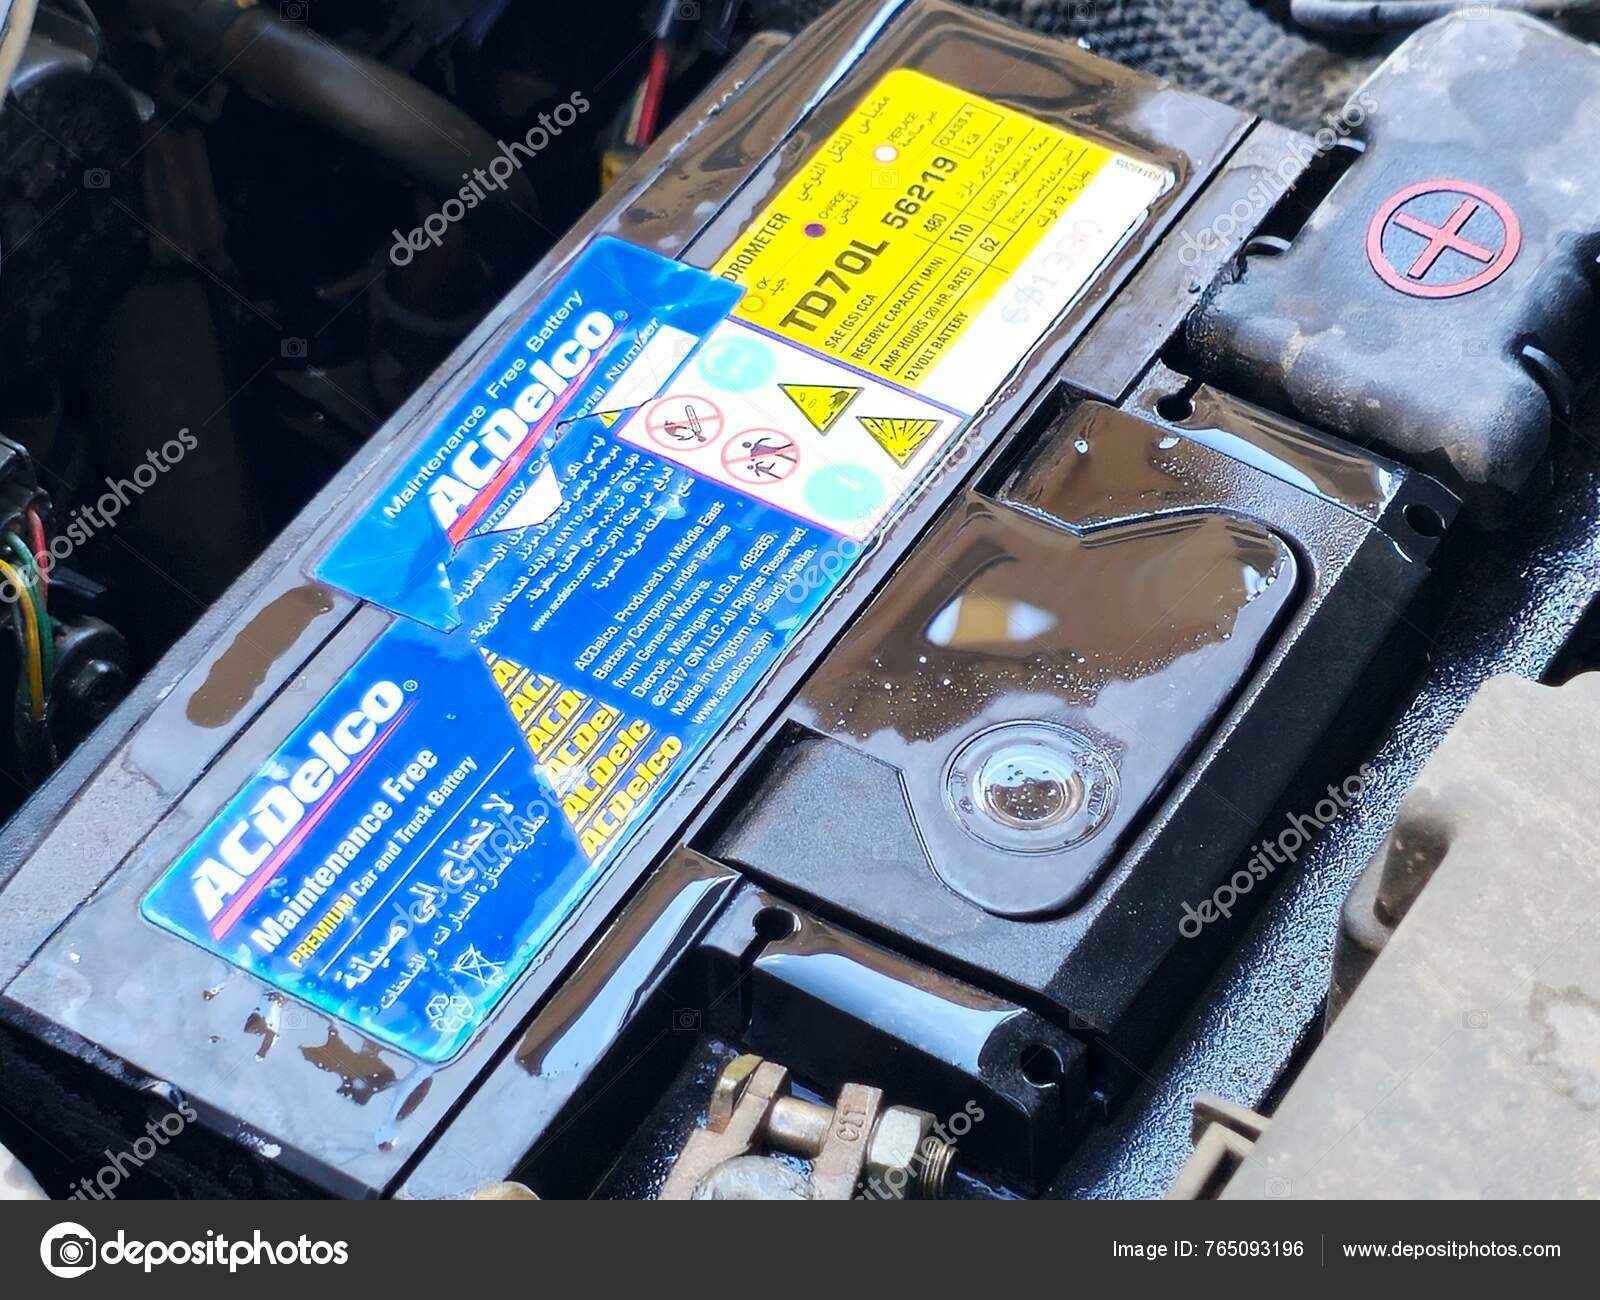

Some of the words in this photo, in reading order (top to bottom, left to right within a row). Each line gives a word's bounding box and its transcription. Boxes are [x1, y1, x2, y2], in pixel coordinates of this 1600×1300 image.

[939, 117, 968, 146] CLASS
[721, 212, 790, 281] DROMETER
[780, 240, 888, 330] TD70L
[881, 156, 957, 229] 56219
[922, 212, 947, 232] 480
[949, 223, 974, 243] 110
[977, 235, 999, 253] 62
[755, 276, 771, 290] OK
[824, 328, 847, 348] SAE
[839, 311, 863, 331] (GS)
[856, 293, 878, 311] CCA
[850, 321, 890, 360] RESERVE
[883, 279, 924, 321] CAPACITY
[919, 256, 946, 280] (MIN)
[879, 348, 902, 371] AMP
[897, 319, 928, 350] HOURS
[922, 305, 940, 320] (20
[946, 266, 974, 291] RATE)
[930, 310, 968, 349] BATTERY
[384, 405, 485, 517] Maintenance
[485, 358, 526, 398] Free
[526, 291, 583, 351] Battery
[903, 369, 920, 381] 12
[911, 347, 936, 370] VOLT
[474, 480, 532, 534] arranty
[574, 625, 622, 671] ACDelco,
[614, 571, 663, 622] Produced
[656, 558, 677, 573] by
[668, 525, 704, 559] Middle
[697, 501, 725, 526] East
[592, 638, 636, 679] Battery
[627, 590, 676, 638] Company
[670, 559, 699, 591] under
[694, 524, 731, 560] license
[612, 661, 642, 688] from
[635, 618, 677, 661] General
[670, 580, 712, 619] Motors.
[631, 658, 674, 697] Detroit,
[667, 607, 717, 654] Michigan,
[709, 573, 744, 604] U.S.A.
[739, 533, 778, 570] 48265,
[670, 683, 703, 715] Made
[696, 670, 714, 684] in
[706, 626, 752, 671] Kingdom
[745, 610, 763, 625] of
[755, 581, 788, 613] Saudi
[780, 548, 817, 584] Arabia.
[683, 645, 708, 667] GM
[700, 623, 725, 647] LLC
[718, 608, 738, 626] All
[731, 575, 766, 610] Rights
[759, 526, 808, 575] Reserved.
[692, 632, 772, 723] www.acdelco.com
[581, 737, 680, 856] ACDelco
[251, 802, 391, 950] Maintenance
[381, 750, 437, 801] Free
[288, 893, 356, 967] PREMIUM
[349, 869, 379, 896] Car
[372, 840, 402, 871] and
[393, 805, 435, 842] Truck
[427, 756, 477, 805] Battery
